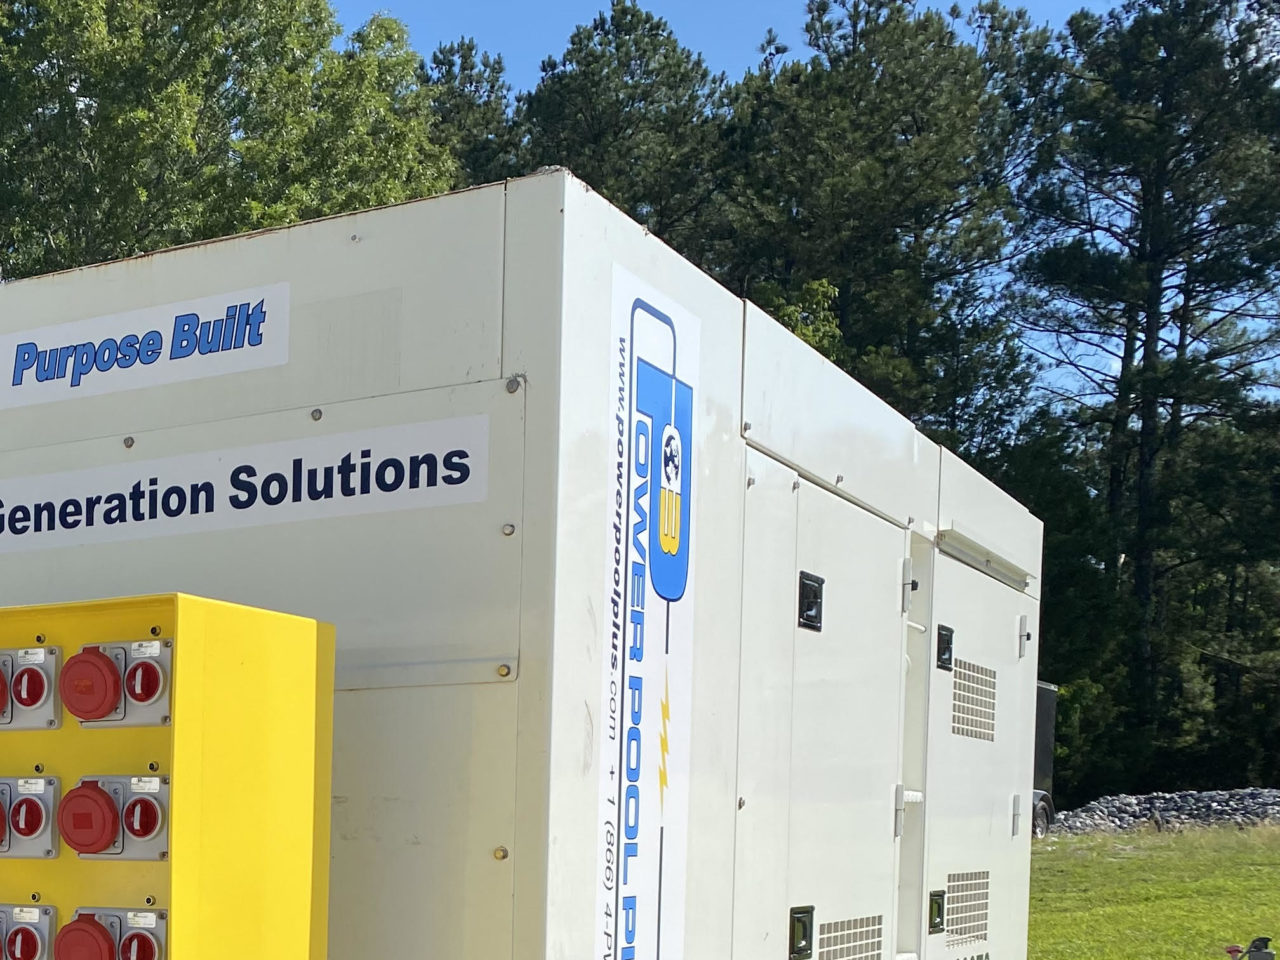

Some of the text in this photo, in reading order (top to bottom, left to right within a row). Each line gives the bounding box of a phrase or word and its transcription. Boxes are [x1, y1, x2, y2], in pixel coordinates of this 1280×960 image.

[11, 298, 267, 387] Purpose Built
[228, 448, 472, 510] Solutions
[609, 337, 626, 741] www.powerpoolplus.com
[628, 356, 694, 662] POWER
[622, 676, 644, 886] POOL
[603, 820, 615, 892] (866)
